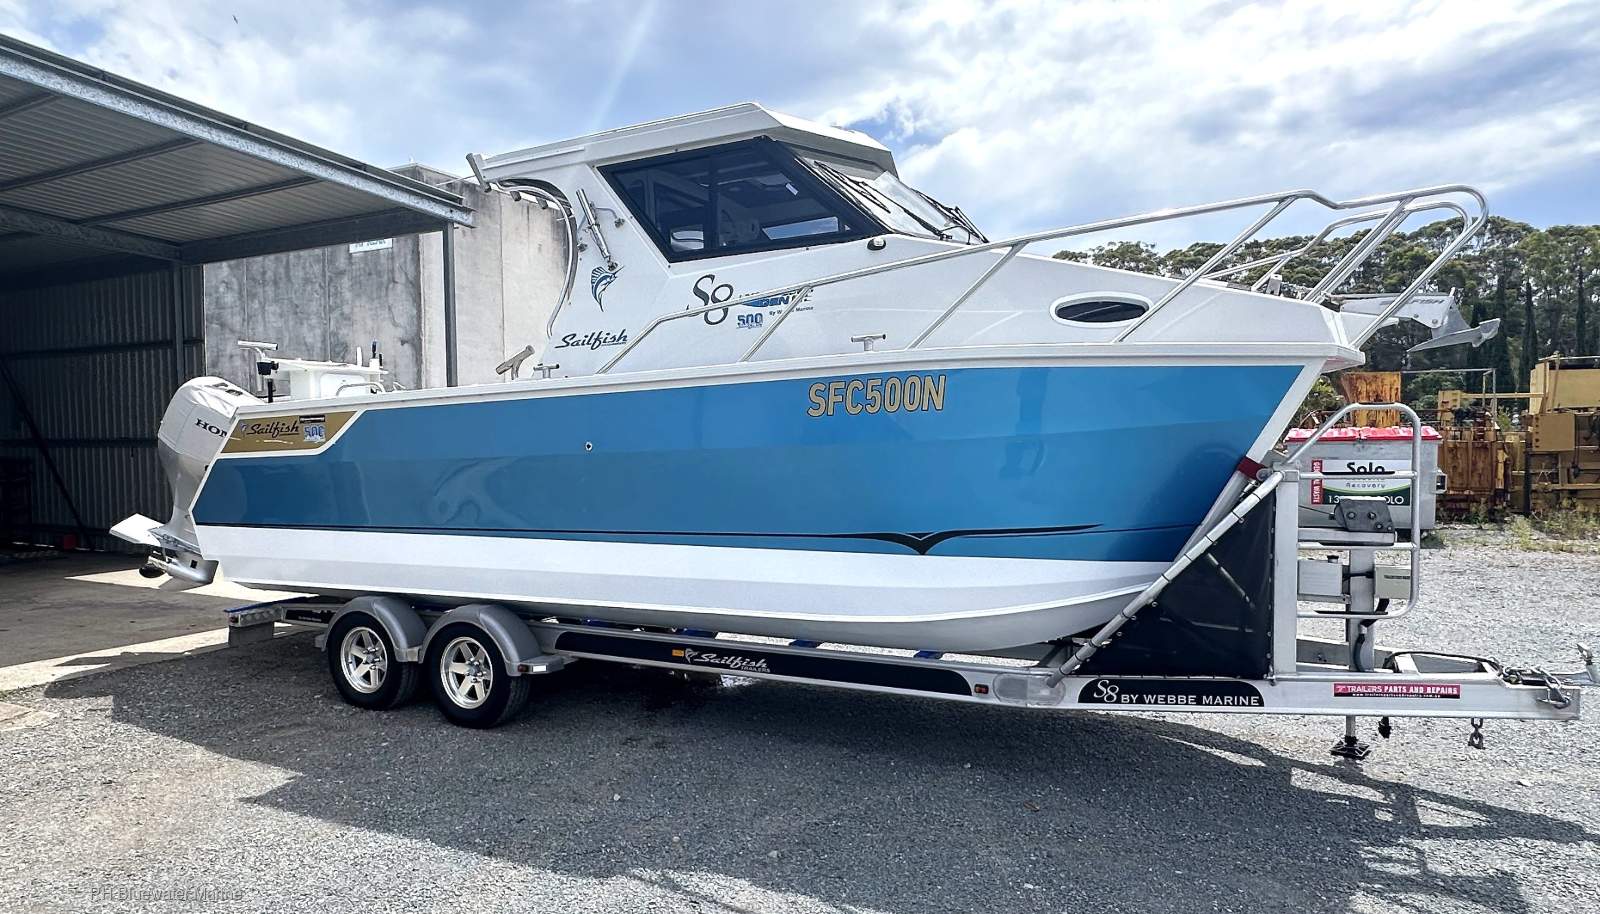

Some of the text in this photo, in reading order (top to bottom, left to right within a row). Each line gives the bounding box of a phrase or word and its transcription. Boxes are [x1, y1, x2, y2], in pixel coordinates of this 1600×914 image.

[554, 329, 628, 350] Sailfish
[807, 375, 947, 417] SFC500N
[194, 418, 228, 437] HON
[246, 421, 300, 438] Sailfish
[694, 653, 768, 669] Sailfish
[1093, 679, 1260, 706] S8 BY WEBBE MARINE
[1347, 685, 1458, 695] TRAILERS PARTS AND REPAIRS
